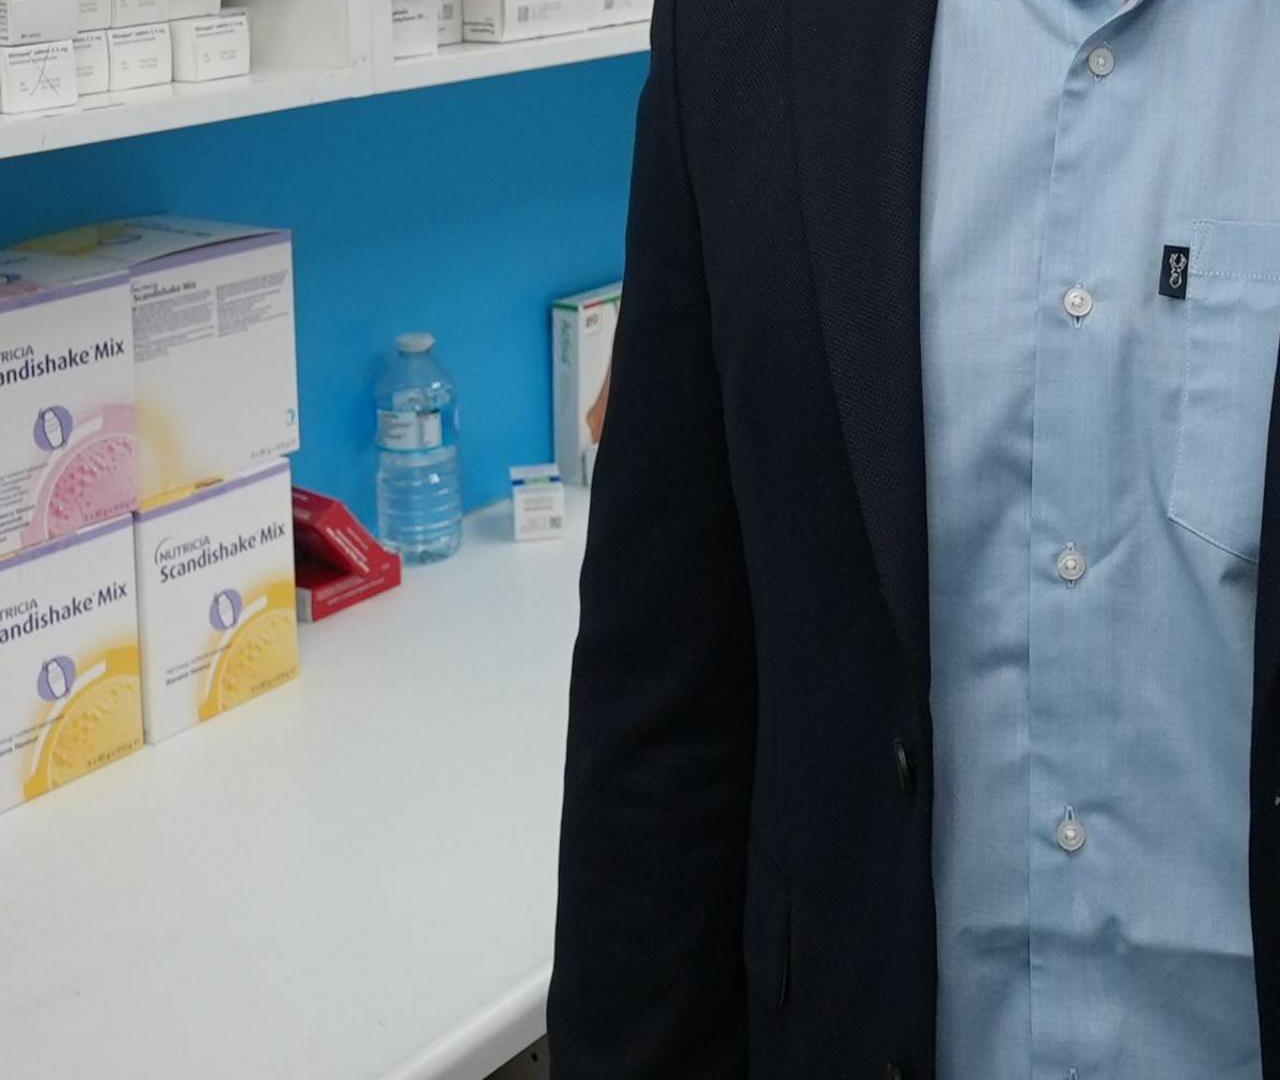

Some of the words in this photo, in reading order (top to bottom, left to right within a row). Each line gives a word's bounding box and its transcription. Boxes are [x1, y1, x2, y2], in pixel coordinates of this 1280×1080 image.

[94, 337, 125, 360] Mix
[159, 534, 211, 564] NUTRICIA
[160, 534, 258, 584] Scandishake
[260, 522, 285, 544] Mix
[97, 581, 127, 607] Mix
